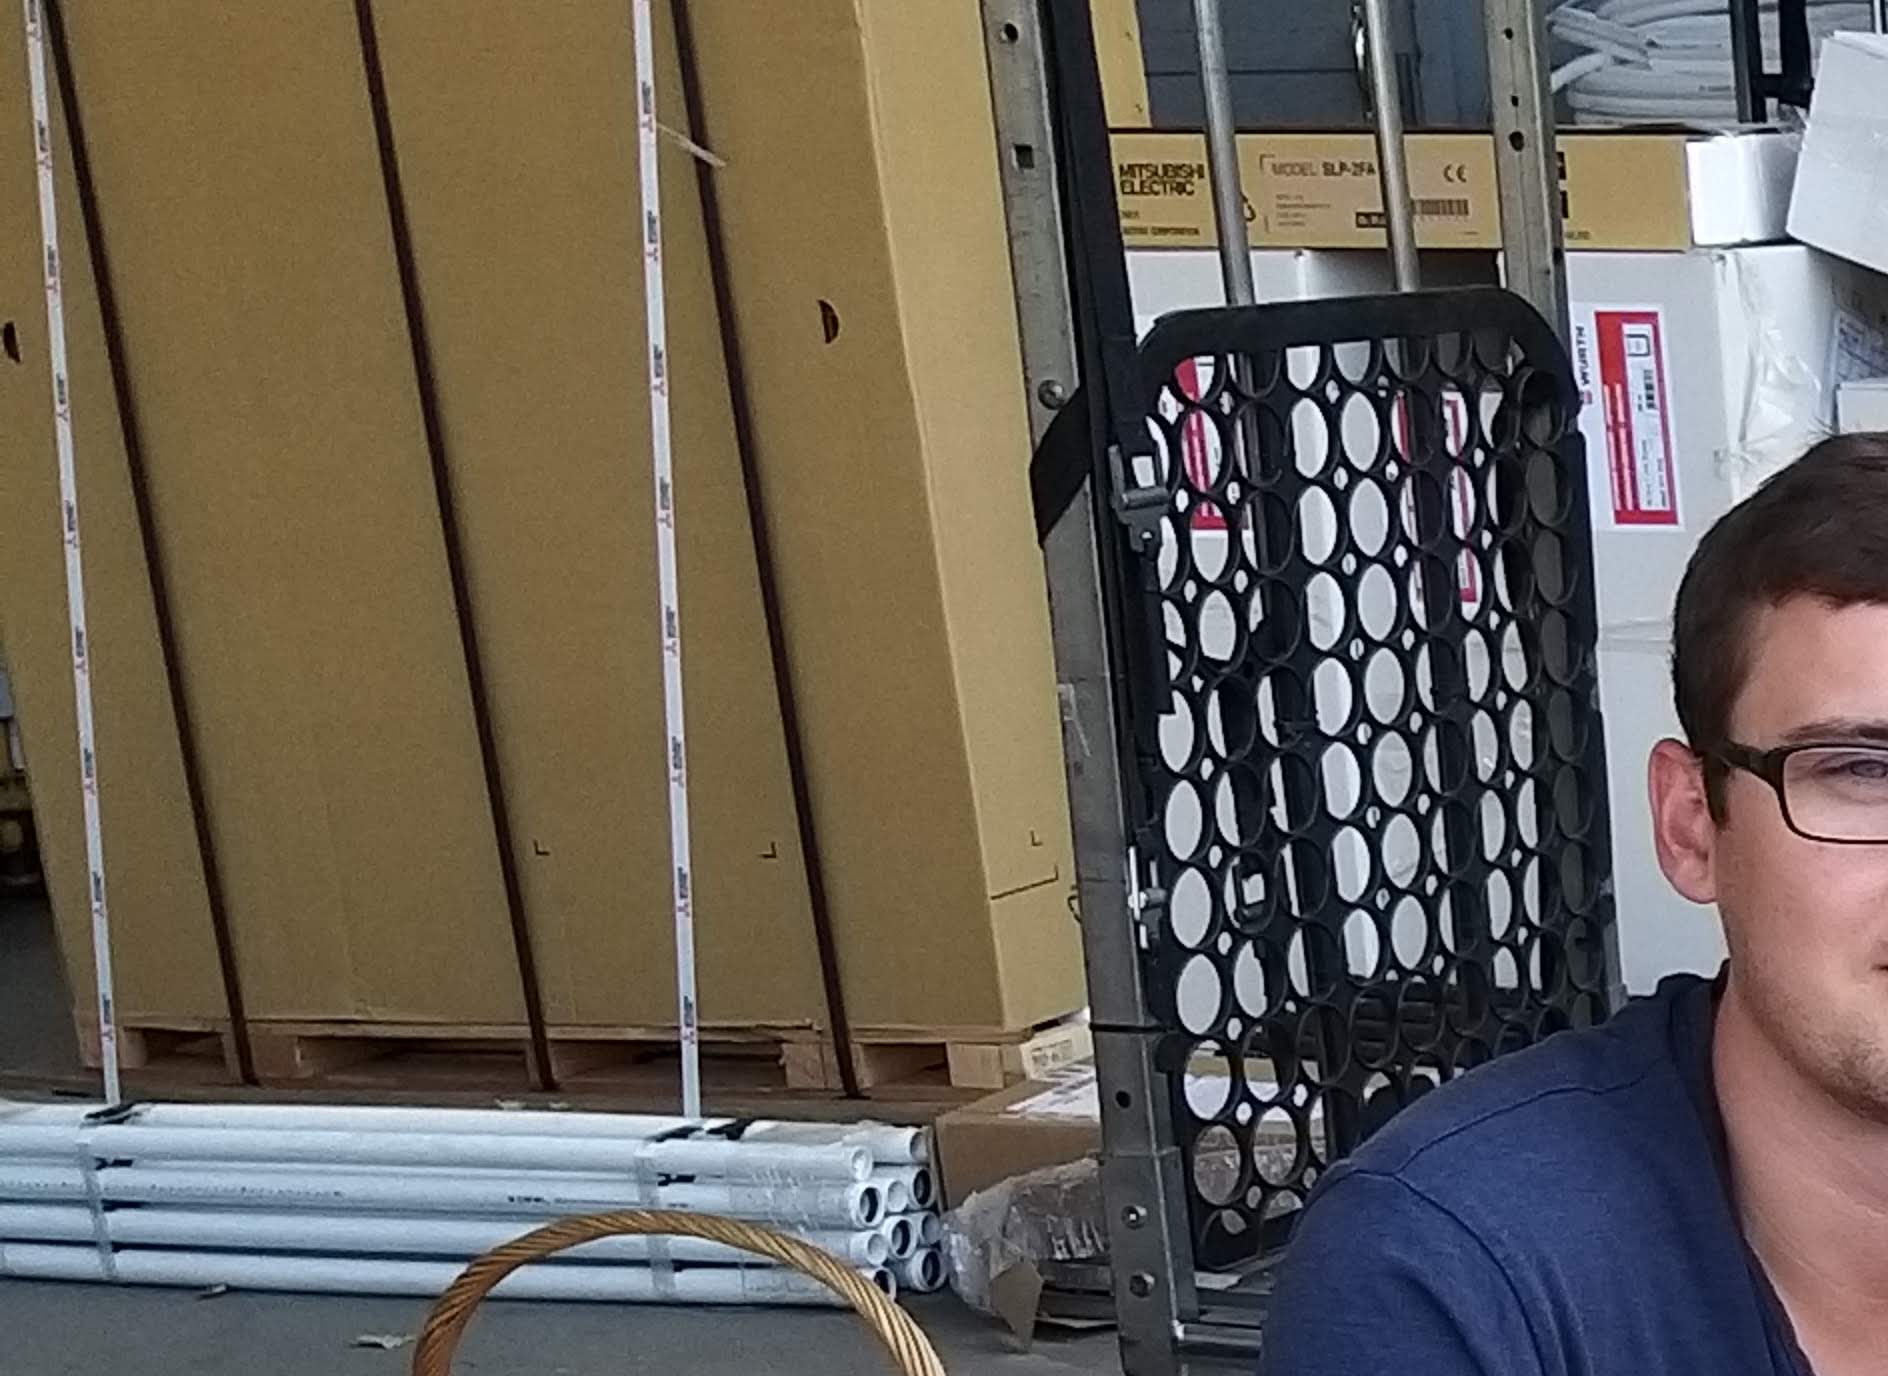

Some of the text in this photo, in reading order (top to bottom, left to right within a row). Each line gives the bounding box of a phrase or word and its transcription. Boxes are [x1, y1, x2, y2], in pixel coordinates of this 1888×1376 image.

[1119, 163, 1205, 180] MITSUBISHI
[1272, 163, 1317, 177] MODEL
[1120, 180, 1195, 196] ELECTRIC
